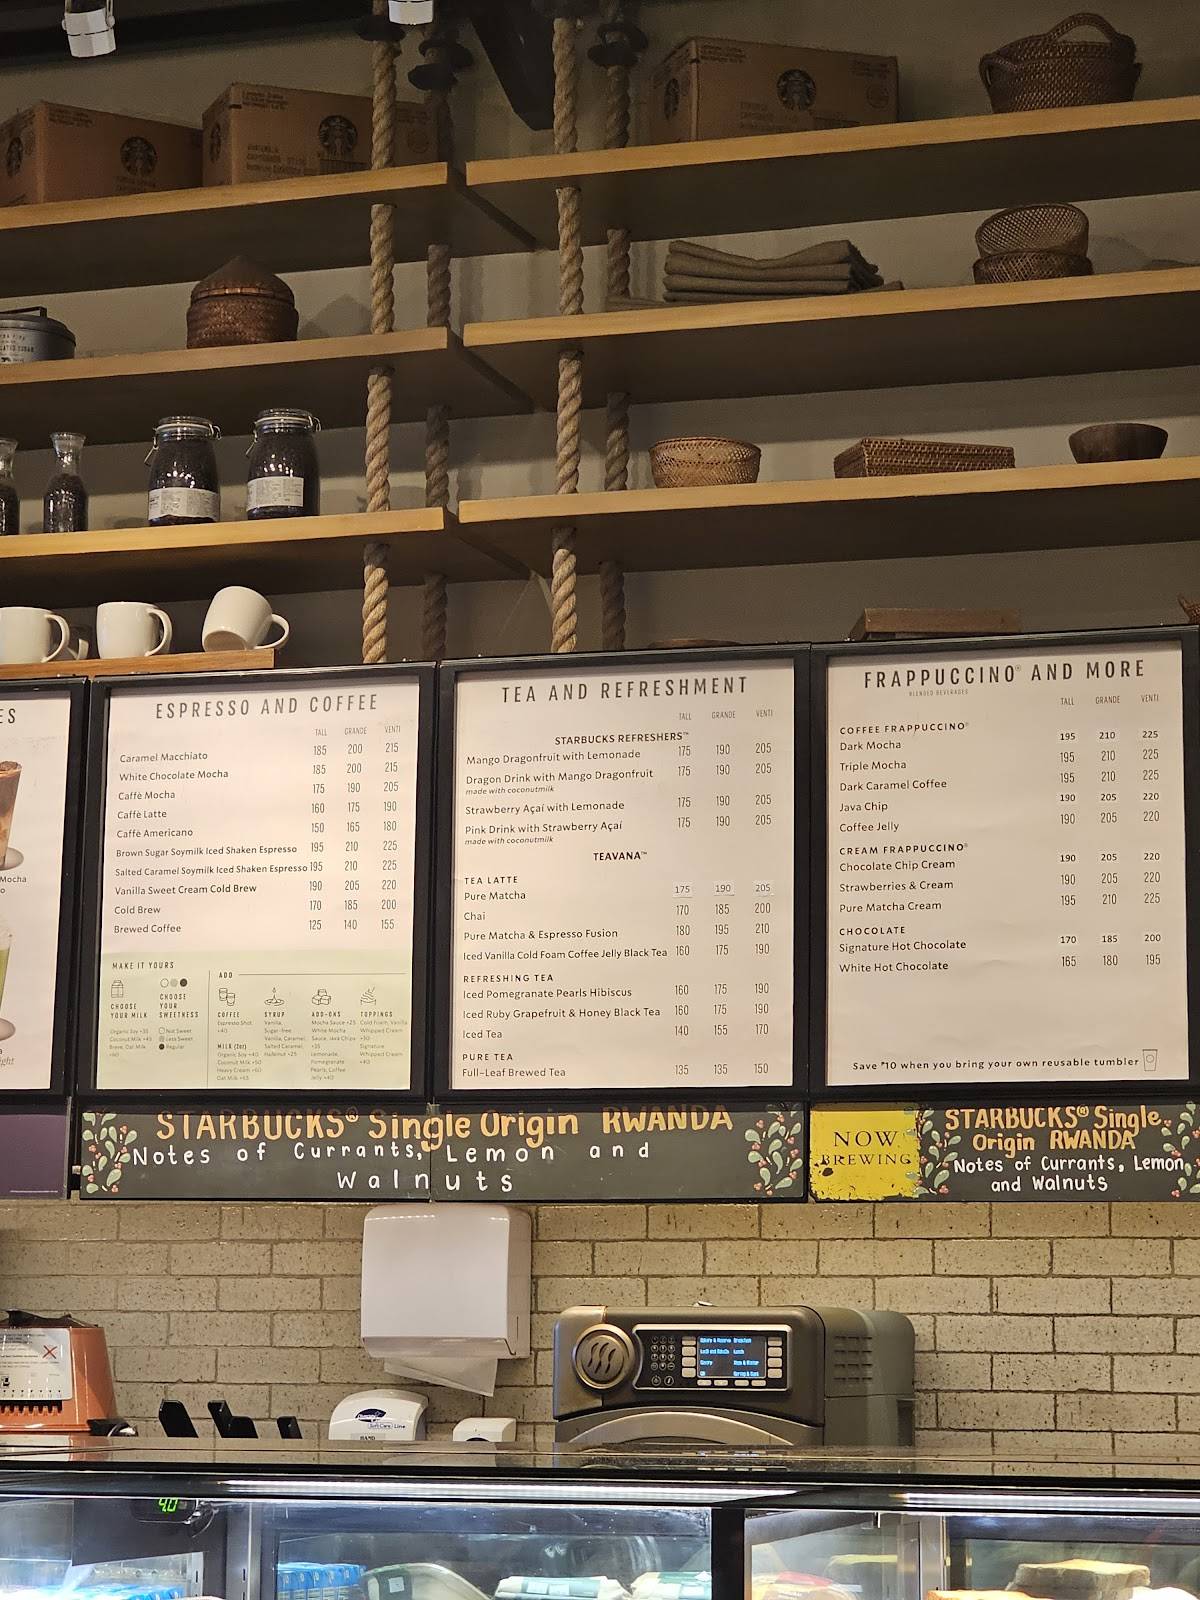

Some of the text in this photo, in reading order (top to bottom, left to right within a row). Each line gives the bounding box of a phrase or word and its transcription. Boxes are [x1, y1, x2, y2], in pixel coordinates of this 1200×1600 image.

[864, 660, 1143, 689] FRAPPUCCINO® AND MORE
[502, 676, 746, 702] TEA AND REFRESHMENT
[1061, 694, 1158, 705] TALL GRANDE VENTI
[156, 694, 376, 719] ESPRESSO AND COFFEE
[712, 711, 735, 719] GRANDE
[756, 709, 773, 717] VENTI
[315, 725, 400, 736] TALL GRANDE VENTI
[840, 726, 879, 734] COFFEE
[555, 735, 614, 745] STARBUCKS
[840, 741, 901, 750] Dark Mocha
[314, 742, 398, 755] 185 200 215
[679, 743, 771, 756] 175 190 205
[120, 752, 207, 762] Caramel Macchiato
[467, 750, 640, 765] Mango Dragonfruit with Lemonade
[120, 770, 228, 781] White Chocolate Mocha
[467, 769, 653, 785] Dragon Drink with Mango Dragonfruit
[508, 785, 554, 793] coconutmilk
[678, 794, 771, 808] 175 190 205
[466, 805, 520, 815] Strawberry
[547, 803, 568, 811] with
[572, 801, 624, 810] Lemonade
[488, 876, 517, 884] LATTE
[115, 886, 145, 895] Vanilla
[210, 884, 230, 893] Cold
[465, 891, 525, 900] Pure Matcha
[114, 924, 181, 933] Brewed Coffee
[310, 919, 394, 930] 125 140 155
[840, 927, 904, 935] CHOCOLATE
[840, 940, 966, 954] Signature Hot Chocolate
[464, 988, 632, 1000] Iced Pomegranate Pearls Hibiscus
[675, 983, 769, 995] 160 175 190
[676, 1063, 768, 1075] 135 135 150
[901, 1061, 928, 1069] when
[956, 1060, 984, 1069] bring
[988, 1061, 1012, 1069] your
[1043, 1058, 1090, 1066] reusable
[1094, 1058, 1138, 1066] tumbler
[463, 1068, 565, 1077] Full-Leaf Brewed Tea
[1094, 1105, 1161, 1136] Single
[369, 1109, 471, 1152] Single
[480, 1108, 578, 1148] Origin
[602, 1104, 733, 1134] RWANDA
[834, 1131, 898, 1148] NOW
[973, 1130, 1136, 1158] Origin RWANDA
[133, 1146, 210, 1165] Notes
[237, 1141, 267, 1161] of
[447, 1144, 554, 1163] Lemon
[590, 1142, 649, 1159] and
[821, 1153, 911, 1166] BREWING
[954, 1158, 1003, 1173] Notes
[1015, 1156, 1031, 1171] of
[1134, 1155, 1184, 1171] Lemon
[337, 1169, 512, 1192] Walnuts
[991, 1174, 1108, 1192] and Walnuts
